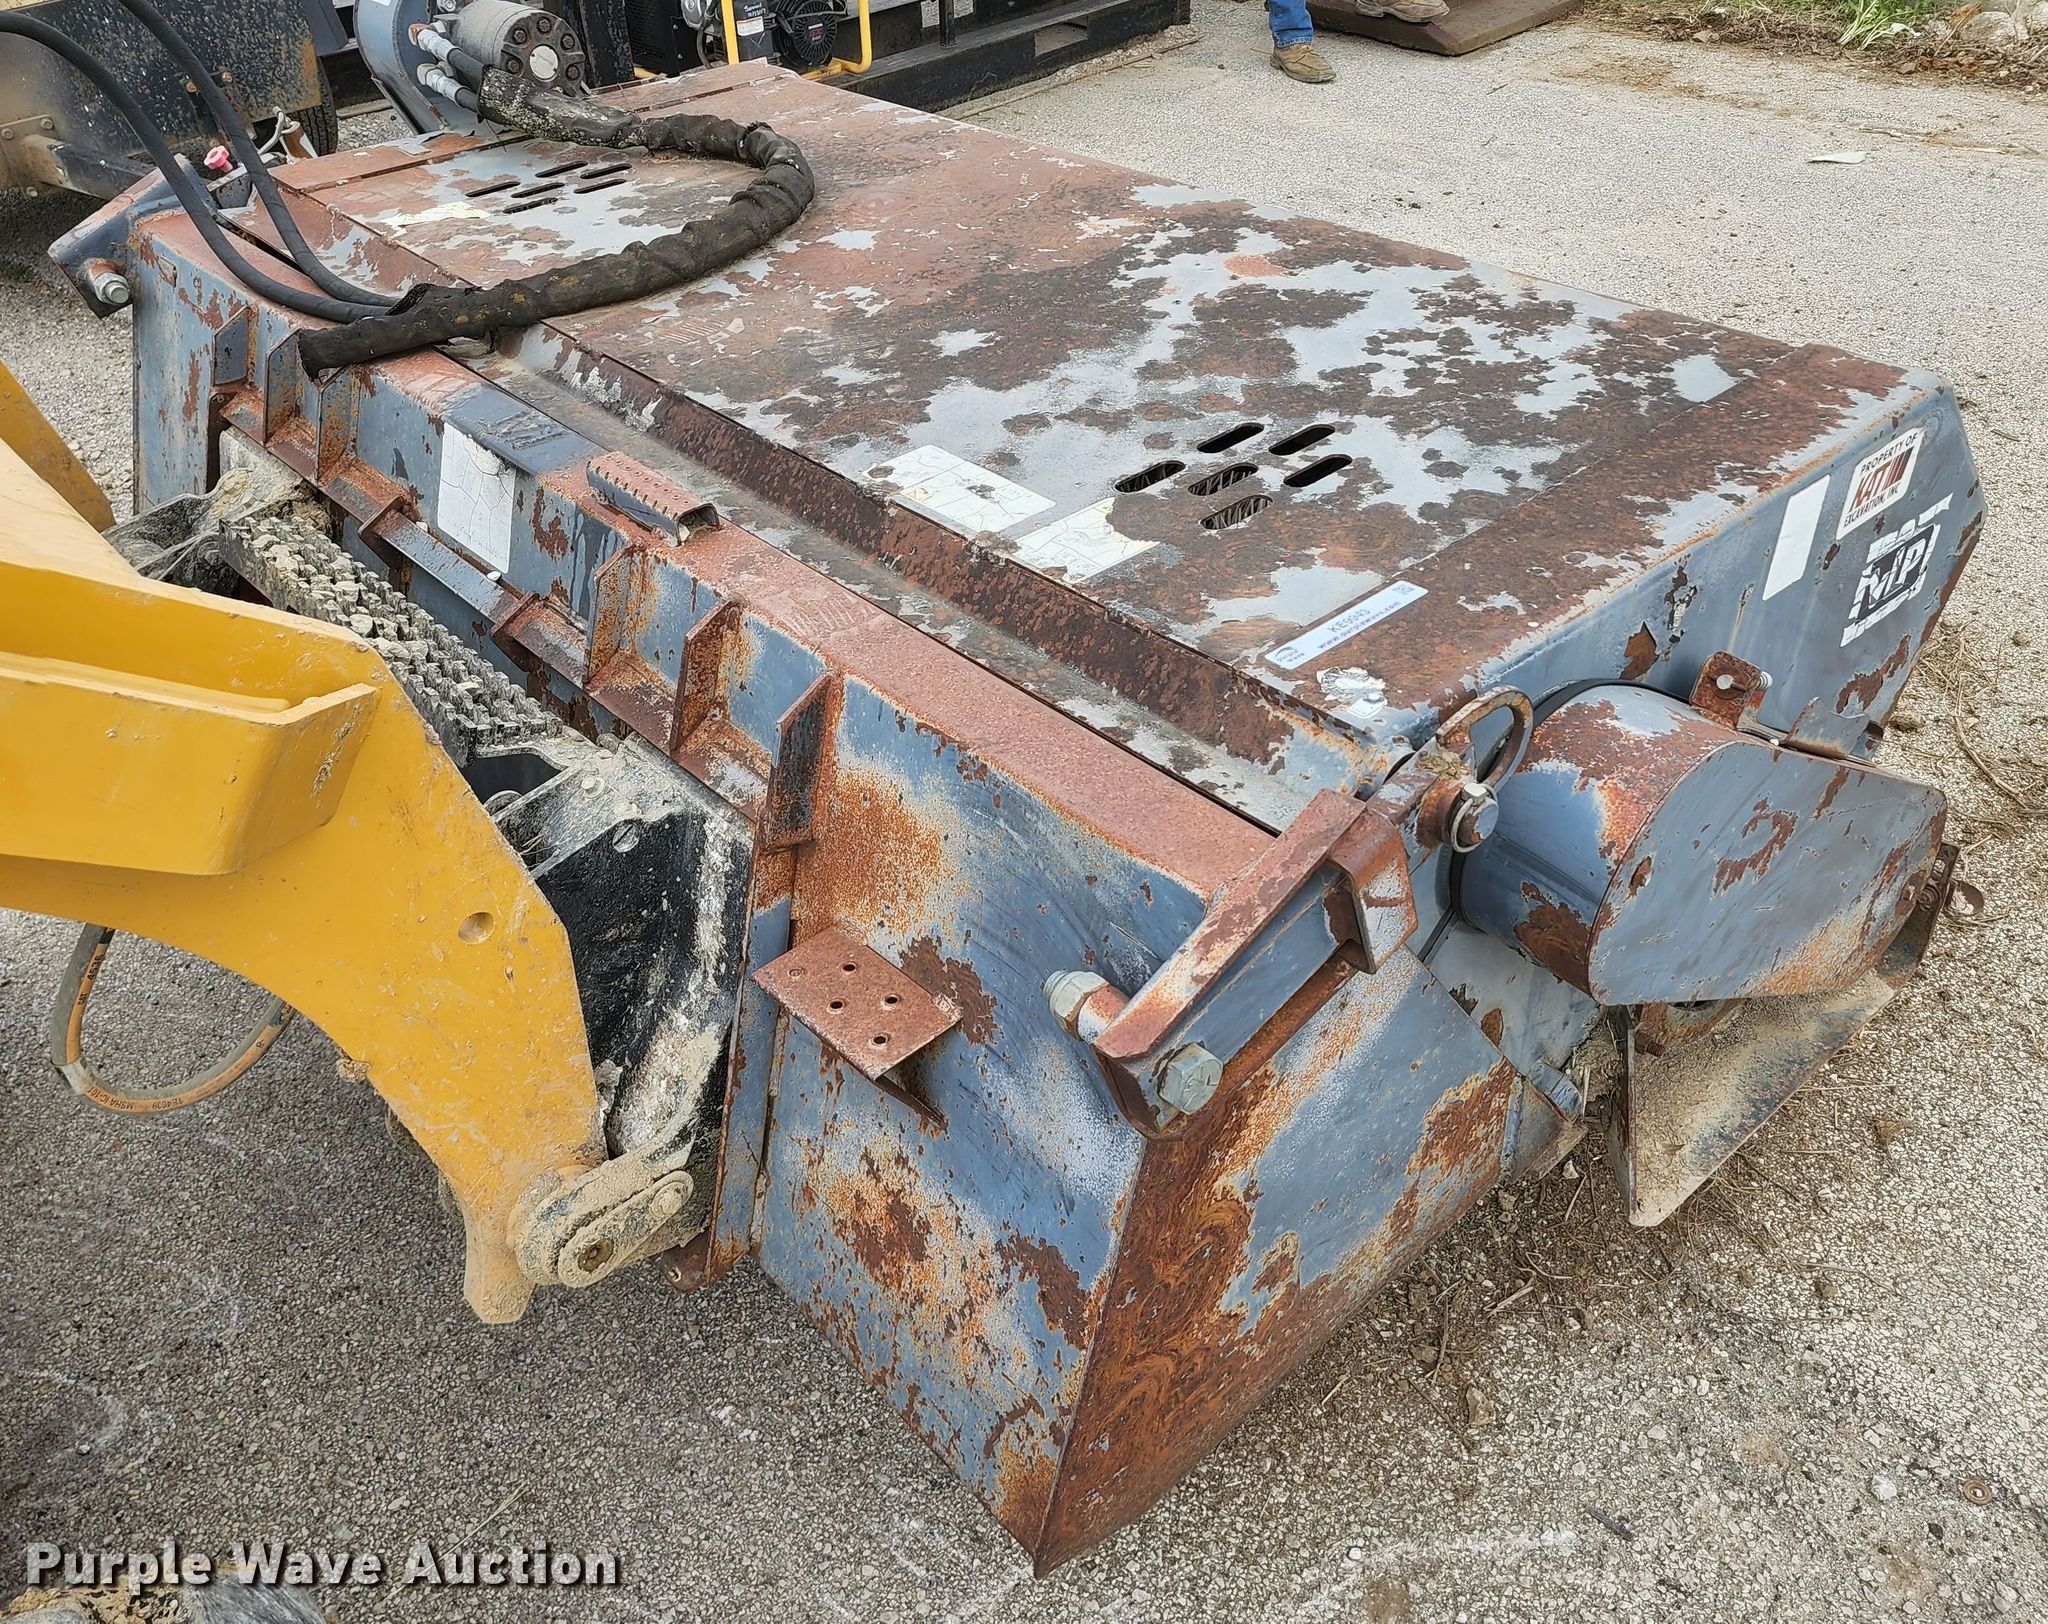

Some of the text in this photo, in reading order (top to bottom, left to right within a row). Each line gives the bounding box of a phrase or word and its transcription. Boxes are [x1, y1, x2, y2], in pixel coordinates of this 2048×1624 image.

[1860, 432, 1918, 474] PROPERTY OF
[110, 1099, 136, 1112] MSHA
